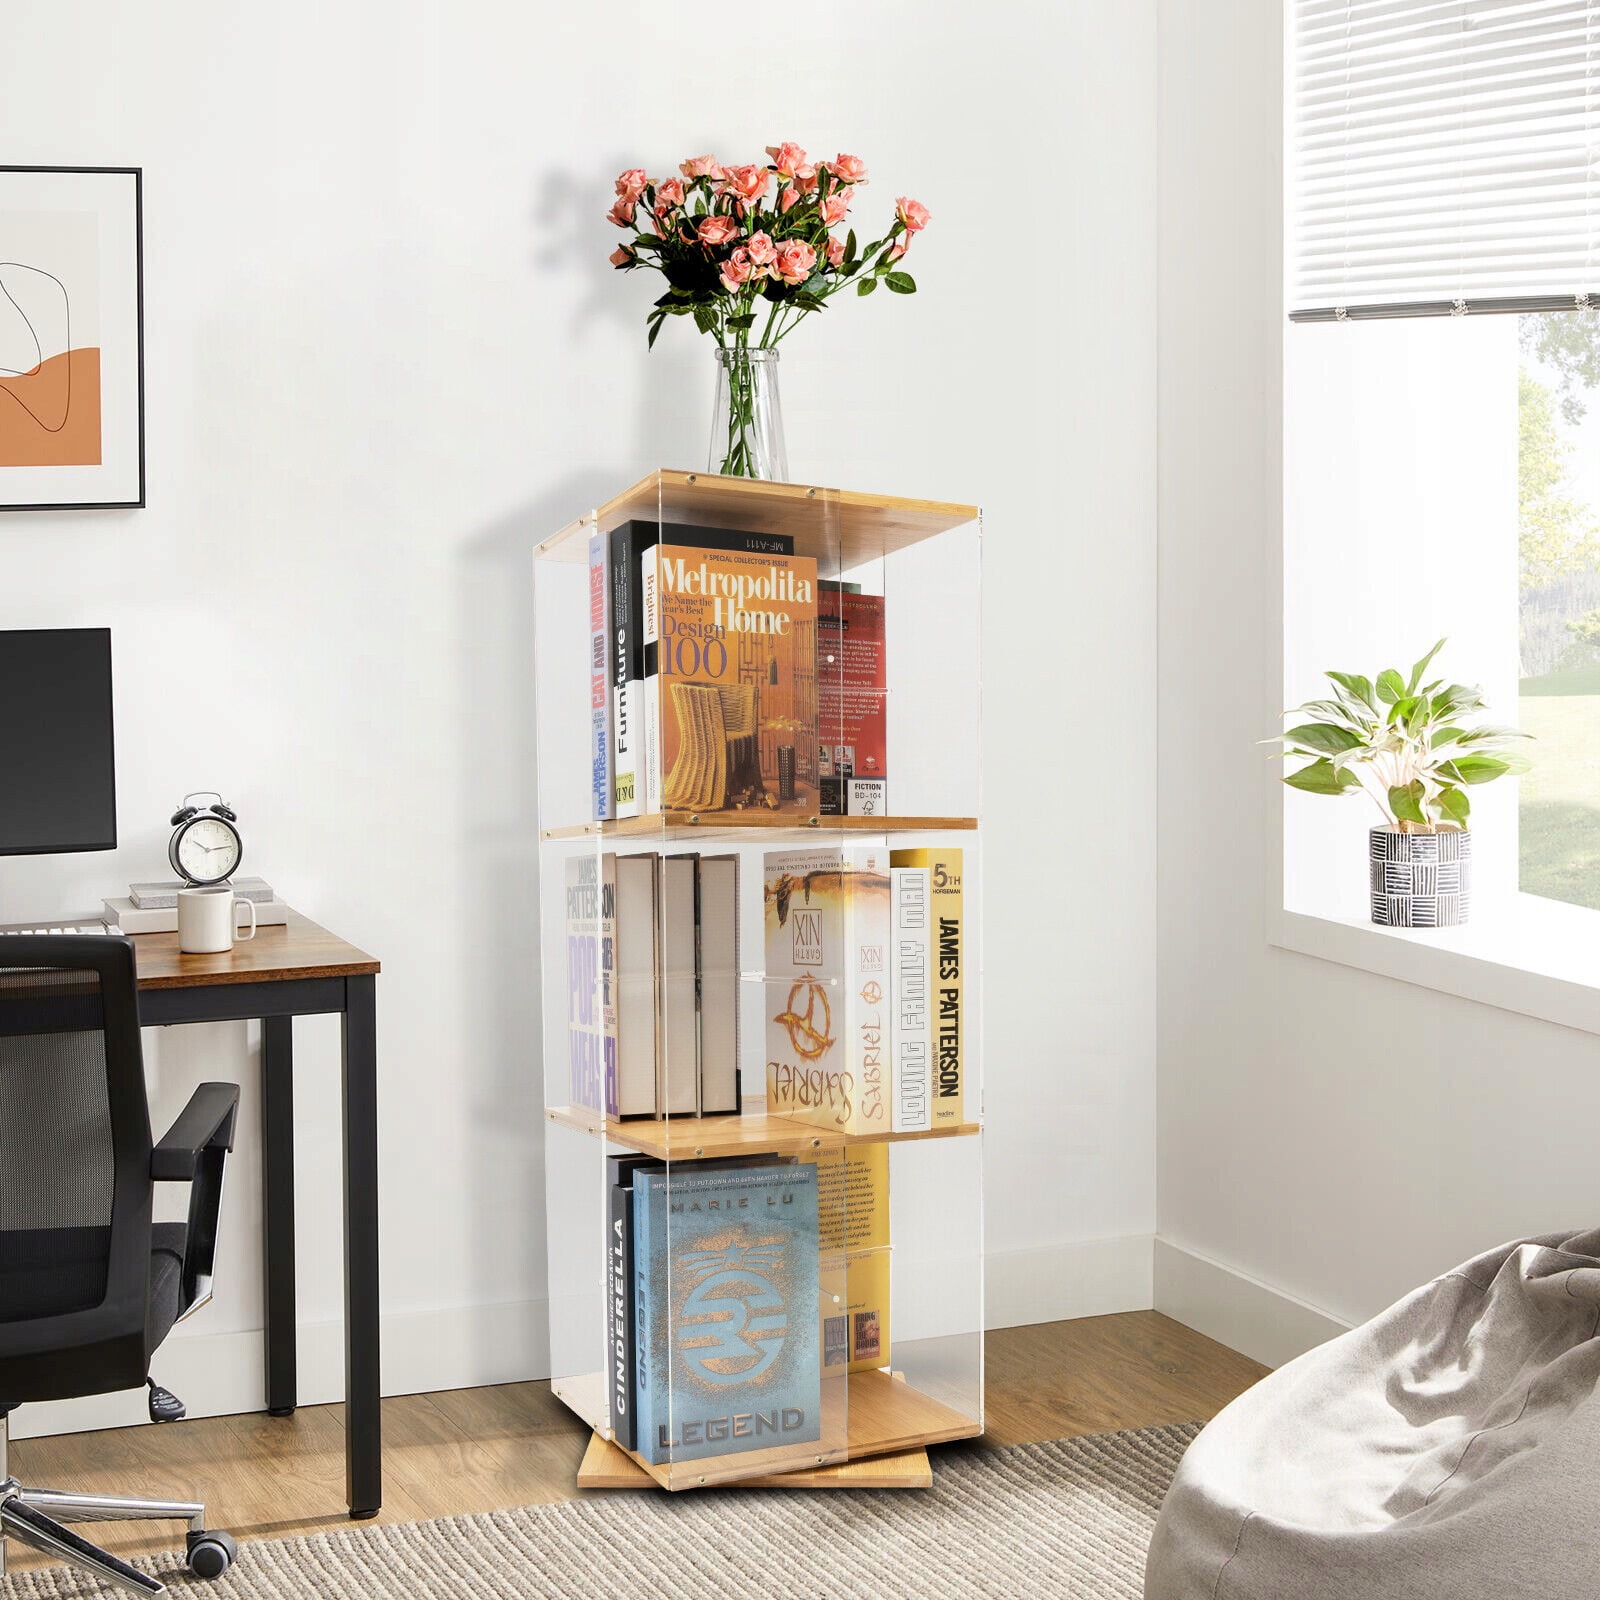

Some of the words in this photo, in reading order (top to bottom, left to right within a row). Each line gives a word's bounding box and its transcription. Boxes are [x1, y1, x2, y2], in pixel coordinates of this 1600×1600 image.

[709, 554, 732, 563] SPECIAL
[734, 557, 770, 566] COLLECTOR'S
[590, 562, 604, 632] MOUSE
[661, 557, 813, 608] Metropolita
[674, 595, 698, 605] Name
[699, 597, 713, 607] the
[662, 614, 727, 643] Design
[686, 607, 704, 615] Best
[714, 597, 790, 635] Home
[593, 634, 605, 669] AND
[661, 637, 728, 678] 100
[592, 673, 605, 709] CAT
[617, 628, 628, 753] Furniture
[598, 731, 607, 816] PATTERSON
[933, 863, 961, 888] 5TH
[567, 883, 615, 920] PATTERON
[900, 873, 925, 928] MAN
[794, 914, 820, 946] NIX
[939, 916, 959, 980] JAMES
[795, 948, 821, 960] GARTH
[861, 948, 881, 963] NIX
[900, 940, 925, 1031] FAMILY
[939, 988, 959, 1098] PATTERSON
[860, 1013, 884, 1120] SABRIEL
[931, 1051, 939, 1076] MAXINE
[767, 1062, 854, 1125] SABRIEL
[901, 1041, 926, 1126] LOVING
[931, 1077, 939, 1099] PAETRO
[672, 1197, 749, 1213] MARIE
[766, 1194, 794, 1205] LU
[614, 1219, 626, 1415] CINDERELLA
[638, 1271, 647, 1391] LEGEND
[657, 1407, 805, 1449] LEGEND
